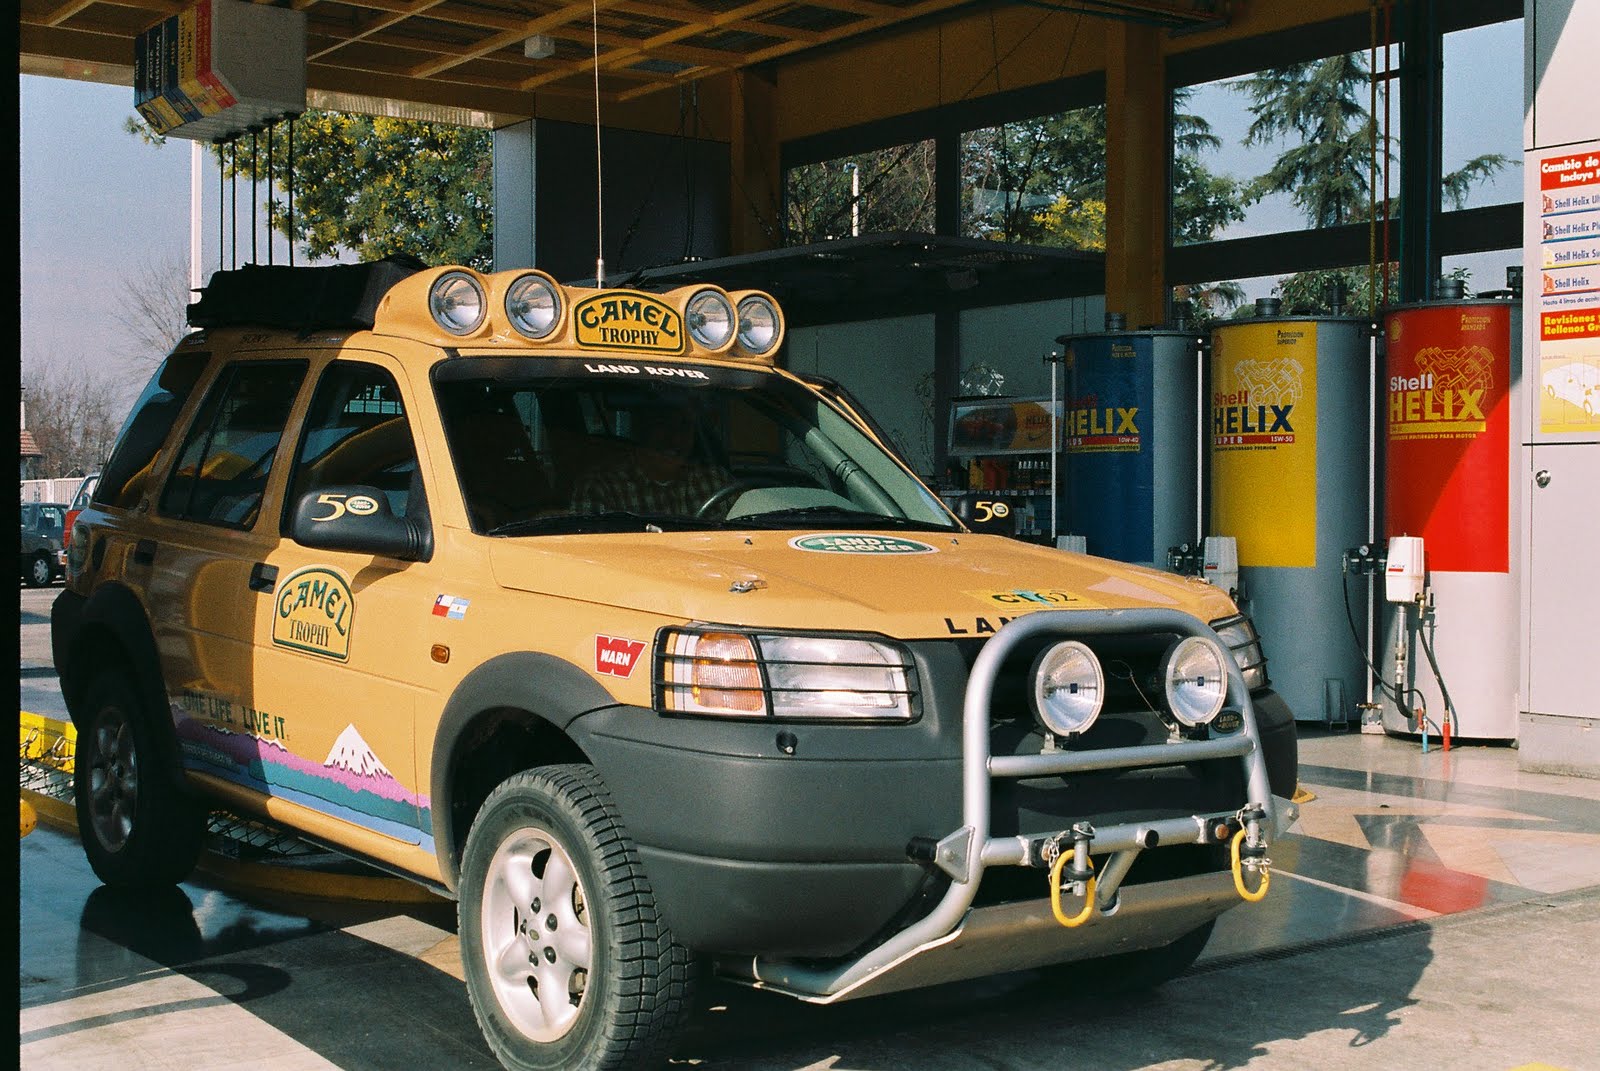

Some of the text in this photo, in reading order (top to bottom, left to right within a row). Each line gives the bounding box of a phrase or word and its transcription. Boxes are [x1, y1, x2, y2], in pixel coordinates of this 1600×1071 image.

[1542, 159, 1582, 173] Cambio
[1585, 156, 1599, 168] de
[1560, 171, 1594, 182] Incluye
[1554, 198, 1571, 208] Shell
[1572, 196, 1590, 206] Helix
[1554, 225, 1571, 235] Shell
[1572, 222, 1589, 233] Helix
[1554, 252, 1571, 262] Shell
[1572, 250, 1589, 260] Helix
[1554, 277, 1590, 289] Shell Helix
[580, 300, 676, 338] CAMEL
[1544, 314, 1596, 326] Revisiones
[599, 327, 660, 346] TROPHY
[1544, 324, 1585, 336] Rellenos
[584, 363, 710, 380] LAND ROVER
[1390, 374, 1433, 391] Shell
[1213, 389, 1249, 406] Shell
[1389, 389, 1486, 422] HELIX
[1065, 407, 1139, 436] HELIX
[1213, 404, 1294, 434] HELIX
[311, 494, 380, 521] 50
[974, 501, 1009, 522] 50
[818, 537, 882, 546] LAND
[279, 580, 348, 637] CAMEL
[289, 618, 332, 648] TROPHY
[600, 648, 631, 667] WARN
[241, 706, 271, 735] LIVE
